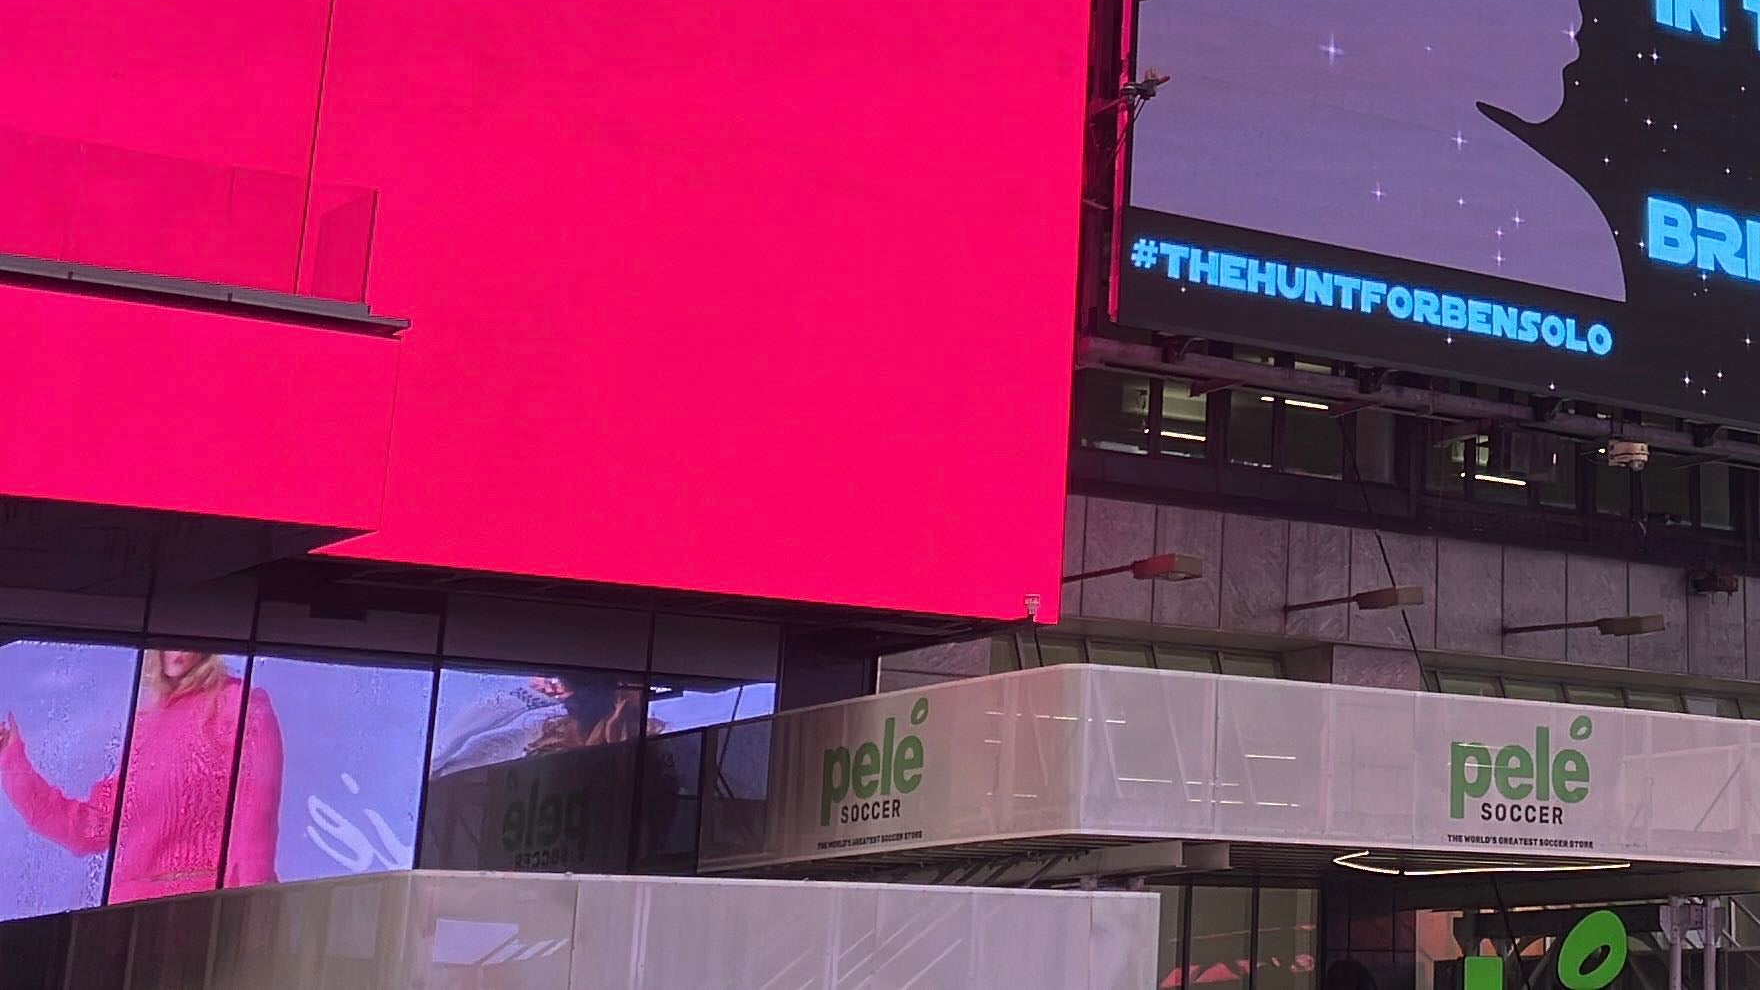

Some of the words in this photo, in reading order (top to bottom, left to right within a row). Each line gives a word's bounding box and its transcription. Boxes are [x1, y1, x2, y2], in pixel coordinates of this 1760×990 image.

[1130, 238, 1614, 356] #THEHUNTFORBENSOLO
[841, 799, 901, 824] SOCCER
[1481, 803, 1563, 825] SOCCER
[1447, 834, 1463, 843] THE
[1464, 835, 1497, 845] WORLD'S
[1498, 836, 1538, 847] GREATEST
[1539, 838, 1568, 848] SOCCER
[1569, 840, 1594, 849] STORE
